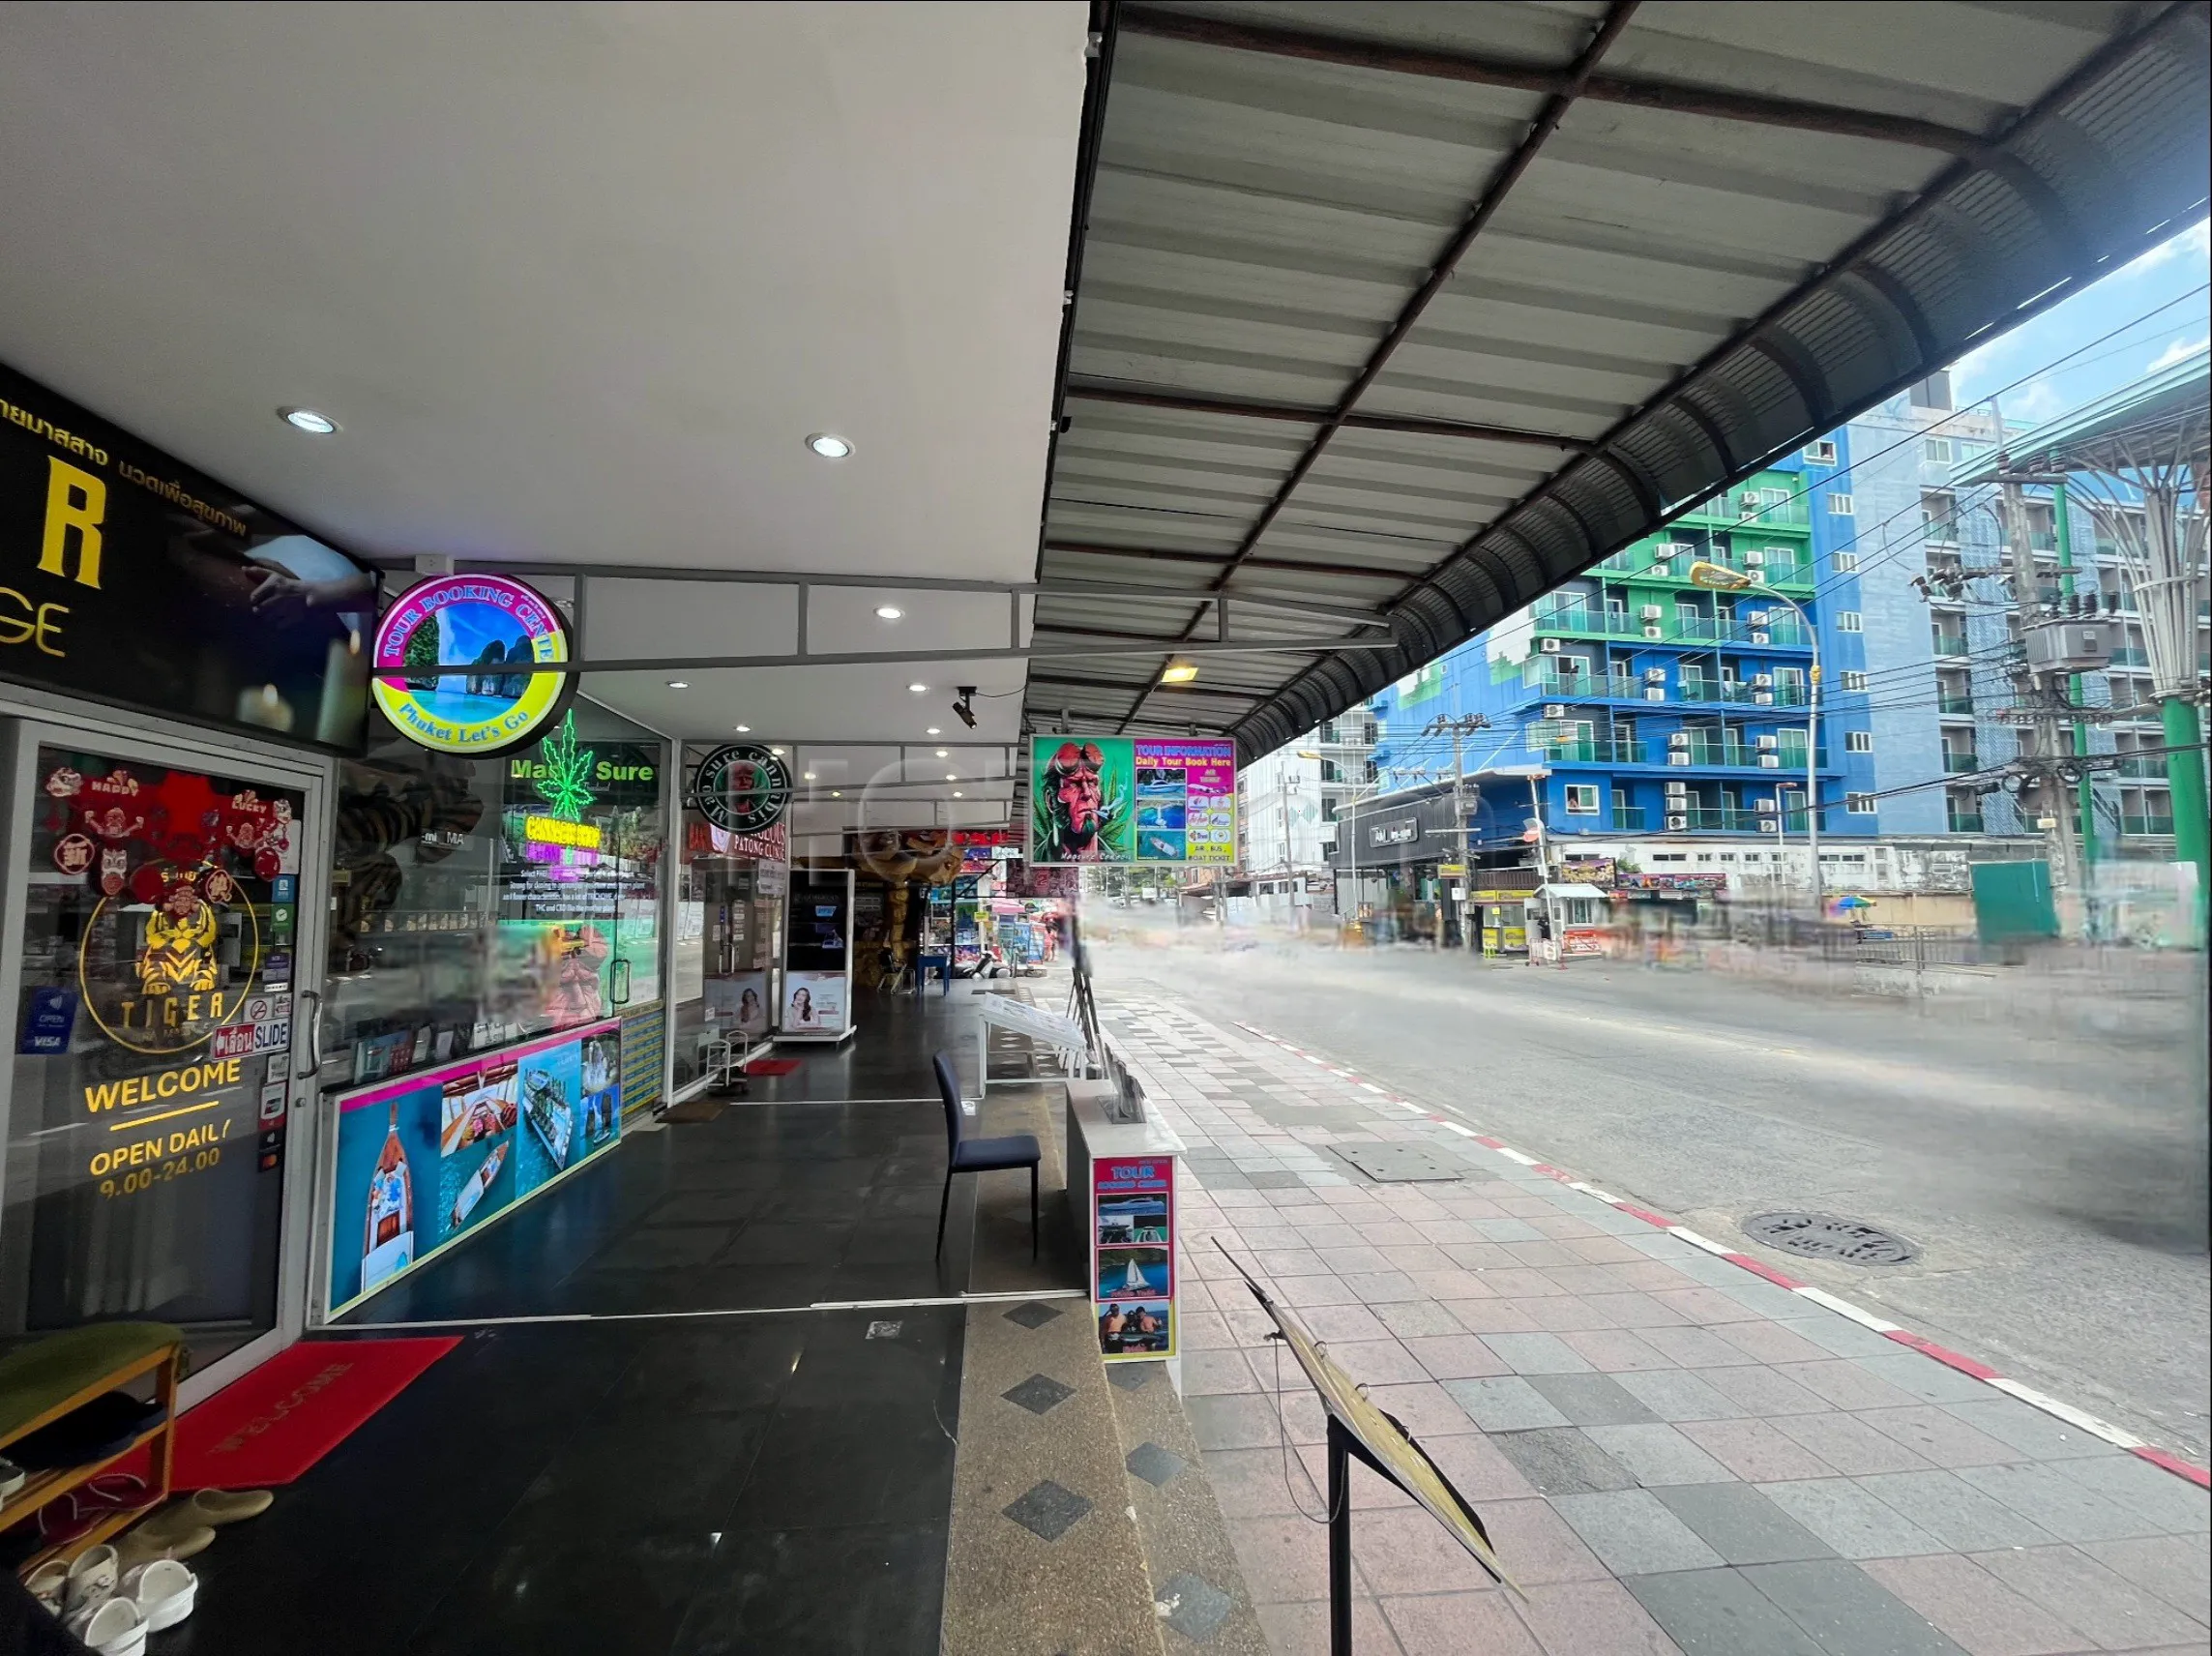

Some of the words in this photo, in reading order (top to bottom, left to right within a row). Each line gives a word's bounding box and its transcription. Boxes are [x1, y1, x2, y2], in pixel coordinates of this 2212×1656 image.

[37, 455, 106, 590] R
[383, 607, 423, 658] TOUR
[420, 584, 516, 613] BOOKING
[515, 604, 555, 662] CENTE
[398, 702, 453, 741] Phuket
[458, 725, 501, 744] Let's
[503, 710, 530, 731] Go
[1135, 745, 1163, 756] TOUR
[1135, 756, 1159, 768] Daily
[1161, 756, 1183, 766] Tour
[1185, 757, 1208, 766] Book
[1211, 757, 1231, 766] Here
[596, 760, 654, 781] Sure
[92, 781, 139, 797] HAPPY
[232, 798, 267, 813] LUCKY
[734, 835, 764, 856] PATONG
[121, 991, 223, 1029] TIGER
[34, 1036, 62, 1047] VISA
[224, 1025, 253, 1055] เลื่อน
[254, 1022, 288, 1050] SLIDE
[84, 1058, 242, 1113] WELCOME
[89, 1138, 162, 1176] OPEN
[99, 1146, 221, 1199] 9.00-24.00
[1110, 1165, 1156, 1179] TOUR
